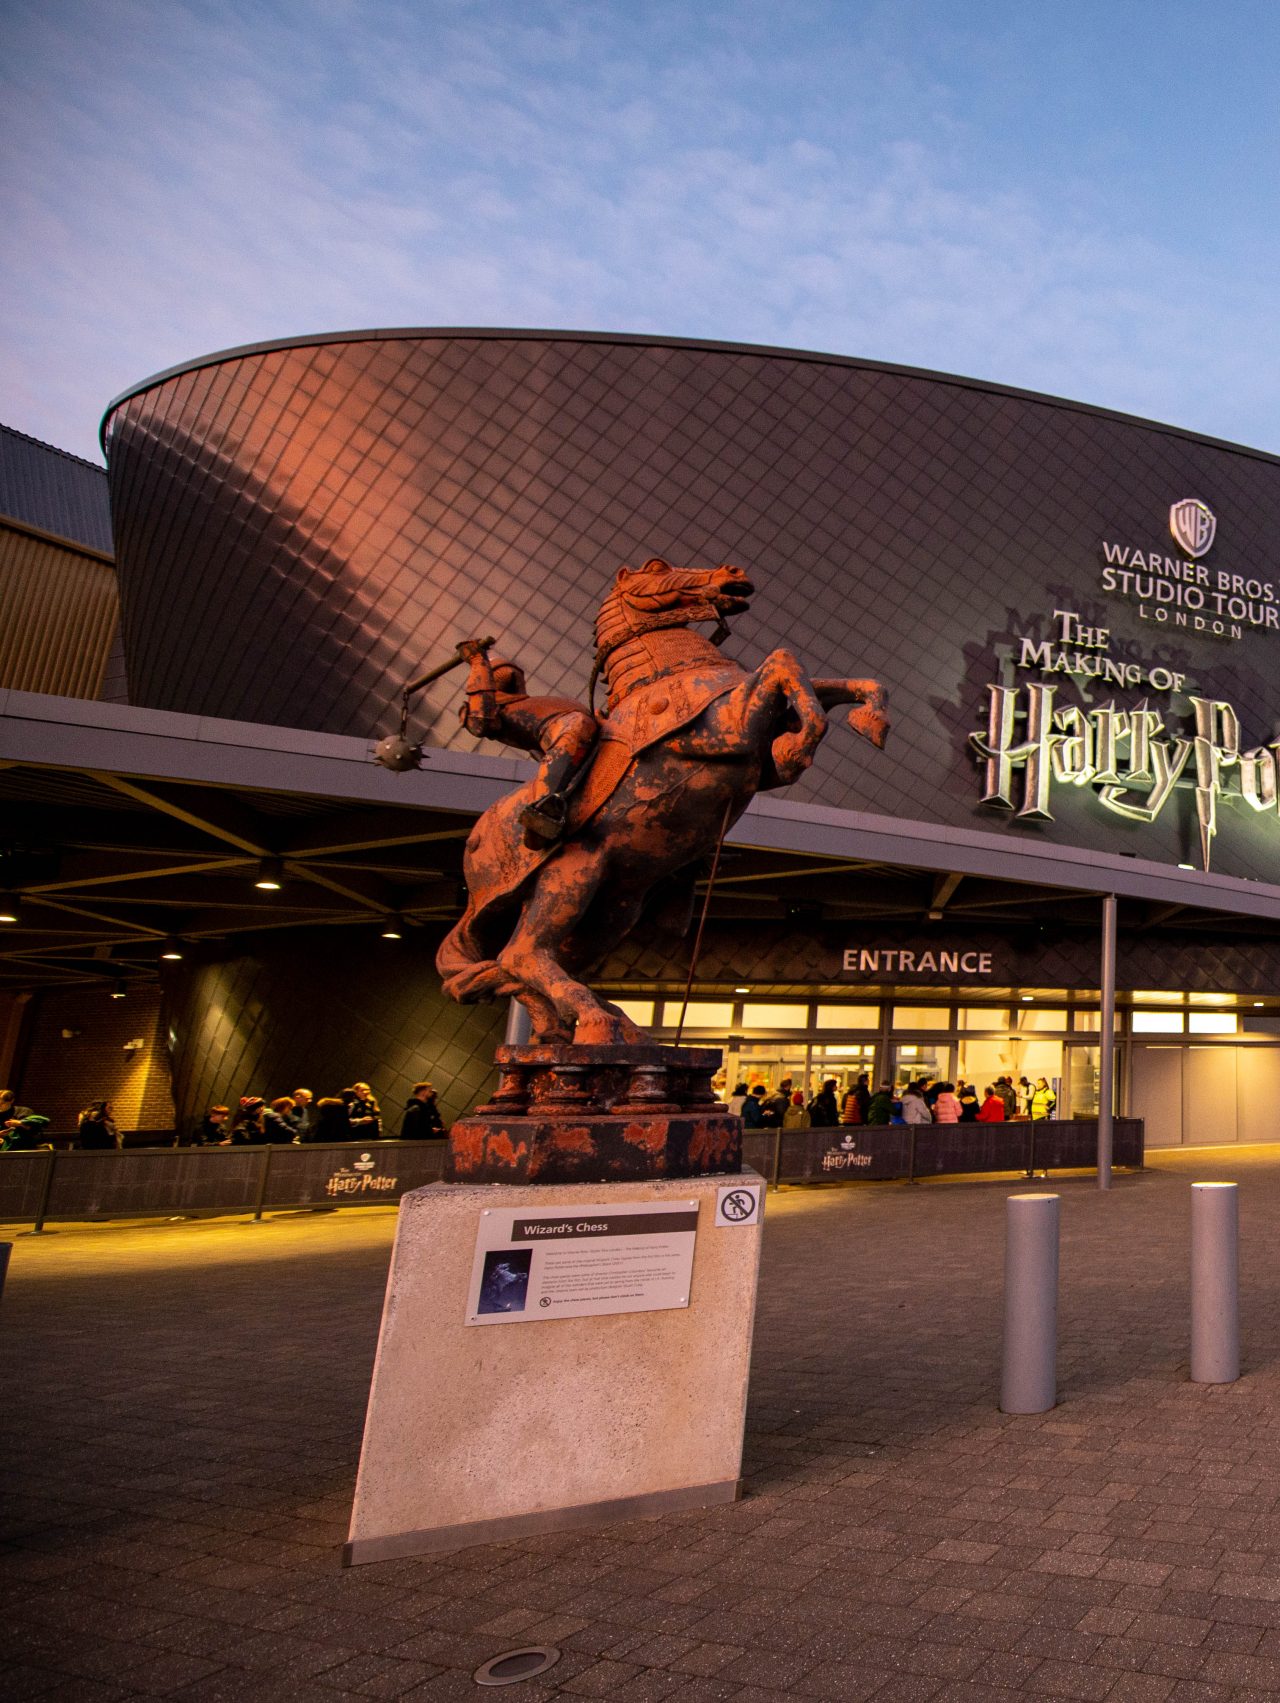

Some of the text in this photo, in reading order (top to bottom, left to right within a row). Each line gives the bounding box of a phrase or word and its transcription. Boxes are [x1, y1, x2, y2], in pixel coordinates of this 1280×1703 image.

[1102, 541, 1280, 604] WARNER BROS.
[1102, 567, 1280, 630] STUDIO TOUR
[1139, 604, 1242, 640] LONDON
[968, 682, 1193, 822] Harry
[843, 949, 993, 973] ENTRANCE
[822, 1152, 872, 1171] Harry Potter
[325, 1174, 398, 1196] Harry Potter
[523, 1222, 609, 1235] Wizard's Chess
